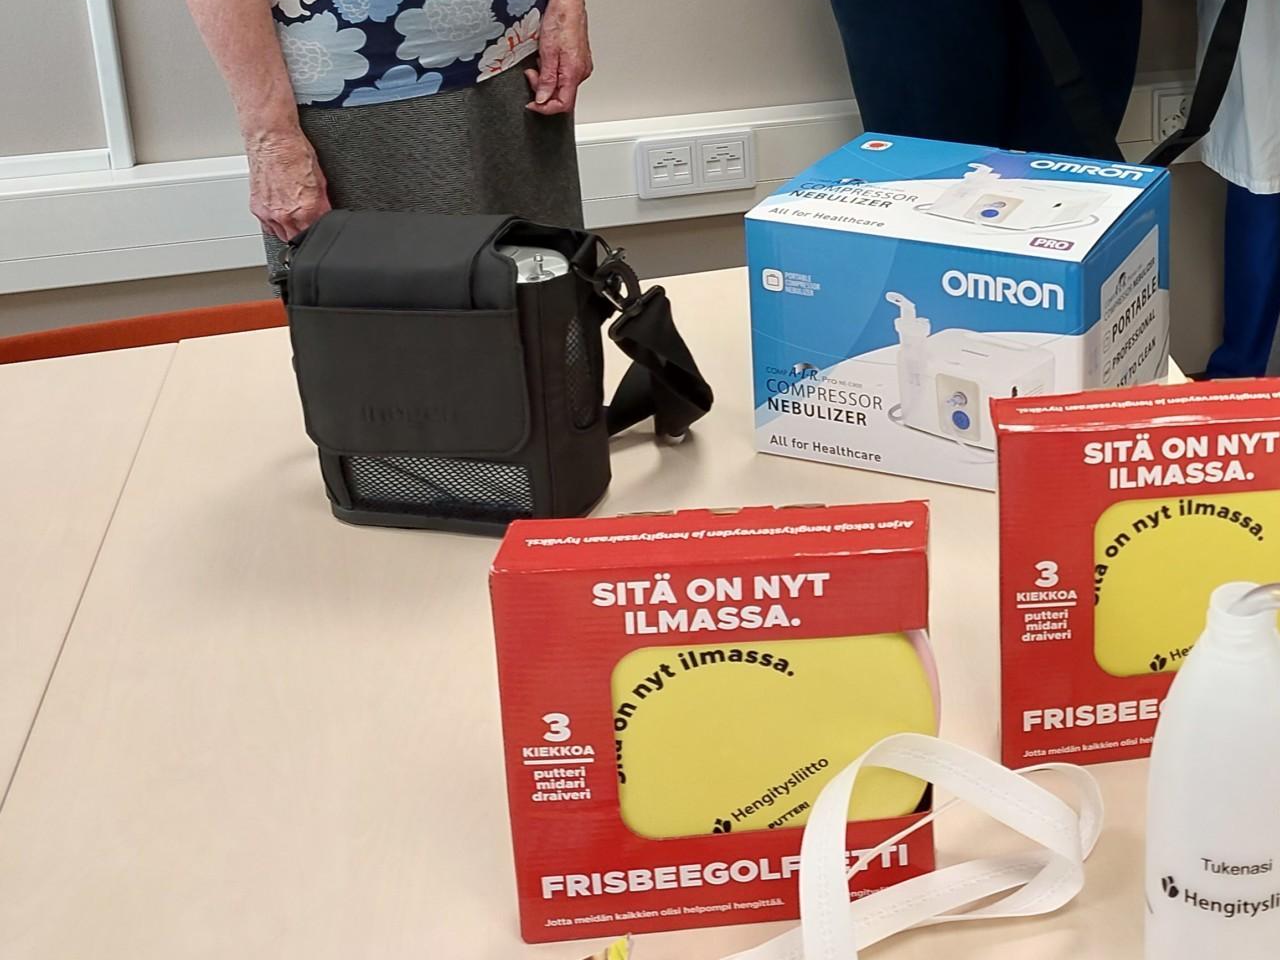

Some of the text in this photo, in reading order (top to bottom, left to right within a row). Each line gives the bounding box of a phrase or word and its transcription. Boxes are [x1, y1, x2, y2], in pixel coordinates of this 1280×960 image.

[1029, 160, 1144, 181] OMRON
[788, 190, 893, 209] NEBULIZER
[799, 182, 920, 203] COMPRESSOR
[768, 207, 885, 228] All for Healthcare
[1034, 238, 1070, 251] PRO
[941, 270, 1065, 311] OMRON
[1111, 276, 1157, 343] PORTABLE
[1138, 336, 1157, 367] CLEAN
[766, 378, 883, 410] COMPRESSOR
[767, 397, 867, 426] NEBULIZER
[769, 434, 882, 462] All for Healthcare
[1083, 431, 1280, 465] SITÄ ON NYT
[1109, 460, 1255, 490] ILMASSA.
[692, 529, 706, 539] ja
[1105, 499, 1264, 558] on nyt ilmassa.
[1034, 560, 1060, 588] 3
[591, 572, 831, 607] SITÄ ON NYT
[1016, 589, 1078, 602] KIEKKOA
[624, 604, 801, 635] ILMASSA.
[1024, 608, 1069, 623] putteri
[1025, 619, 1068, 631] midari
[1021, 629, 1072, 642] draiveri
[613, 648, 796, 732] on nyt ilmassa.
[541, 712, 572, 742] 3
[522, 745, 595, 758] KIEKKOA
[533, 765, 587, 781] putteri
[535, 777, 586, 790] midari
[531, 788, 592, 802] draiveri
[730, 757, 829, 823] Hengitysliitto
[767, 800, 811, 830] PUTTERI
[1200, 857, 1273, 875] Tukenasi
[544, 916, 573, 928] Jotta
[574, 911, 614, 925] meidän
[614, 908, 659, 921] kaikkien
[660, 906, 682, 917] olisi
[683, 902, 732, 916] helpompi
